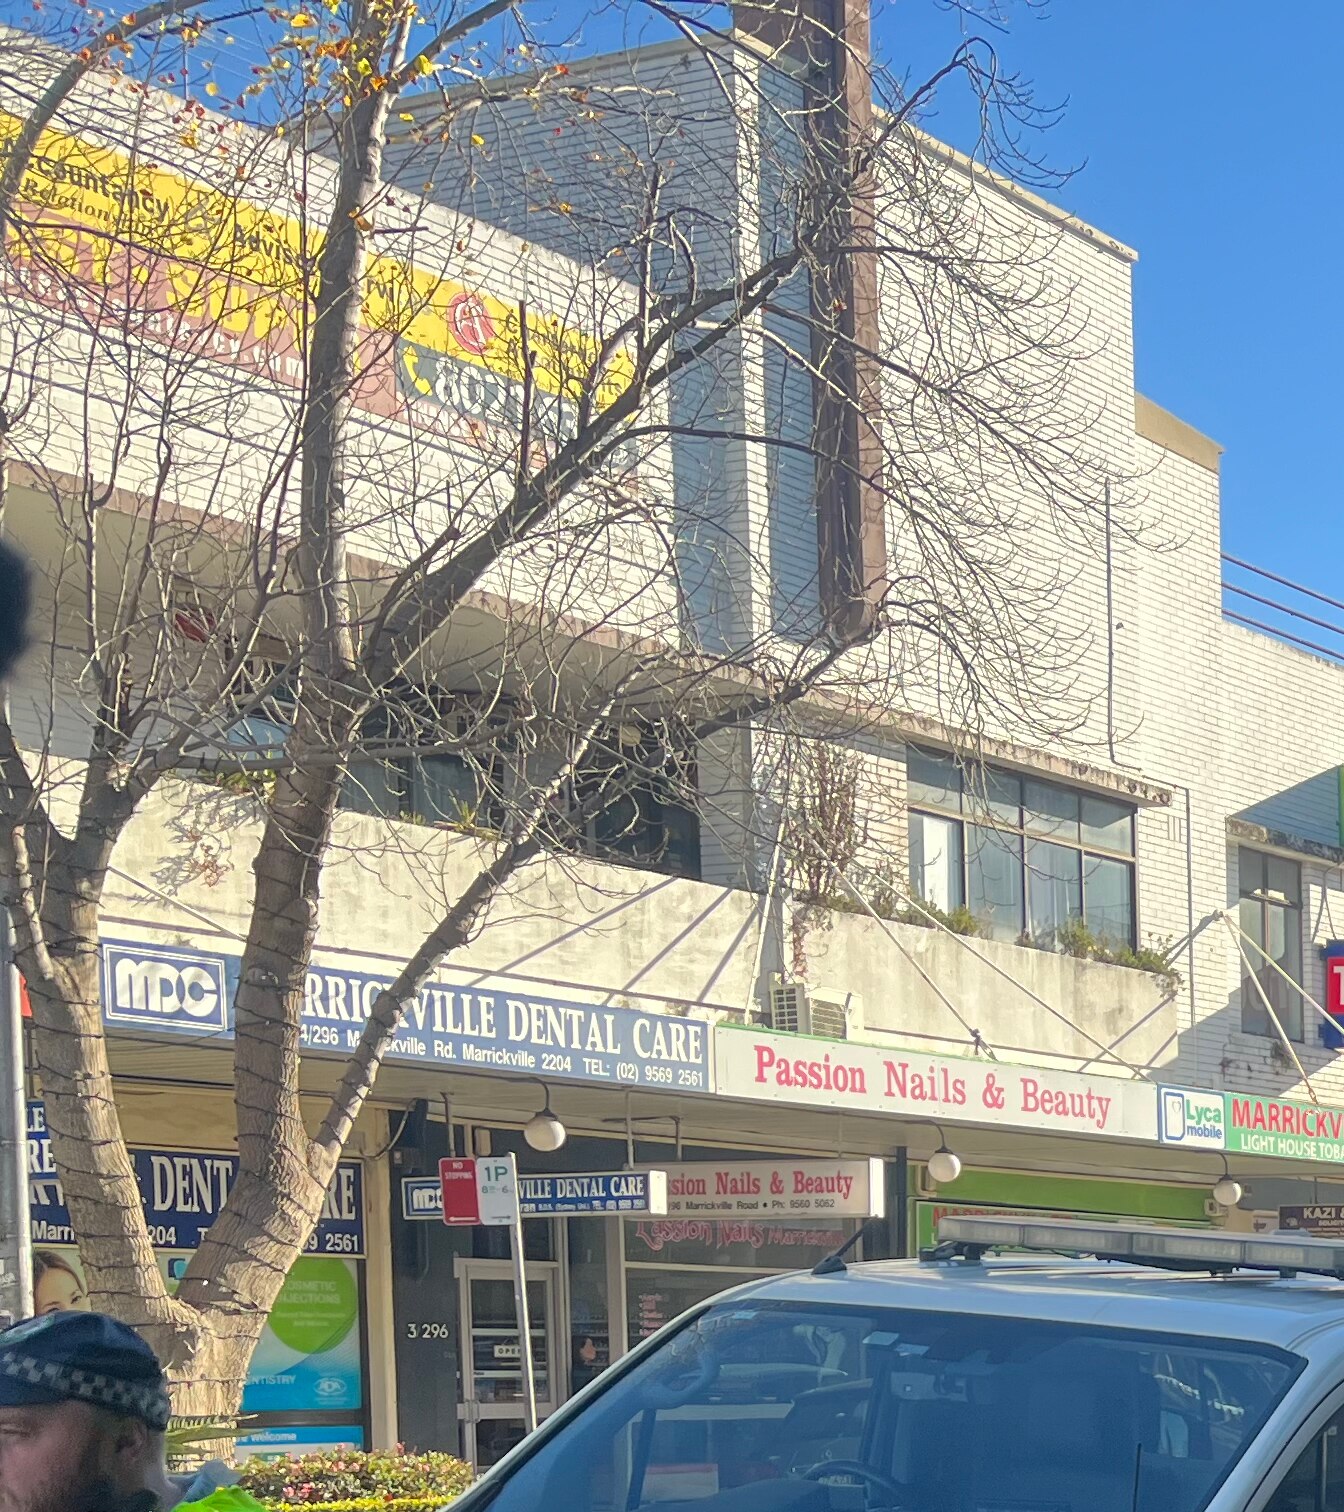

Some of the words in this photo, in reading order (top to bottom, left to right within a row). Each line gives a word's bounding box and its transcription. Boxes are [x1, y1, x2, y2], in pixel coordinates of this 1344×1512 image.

[115, 956, 218, 1018] MDC
[300, 972, 497, 1039] RRICVILLE
[506, 998, 621, 1056] DENTAL
[632, 1017, 703, 1064] CARE
[433, 1039, 457, 1060] Rd.
[462, 1042, 535, 1069] Marrickville
[541, 1052, 572, 1073] 2204
[582, 1056, 611, 1077] TEL:
[616, 1062, 640, 1082] (02)
[645, 1065, 673, 1084] 9569
[678, 1069, 704, 1088] 2561
[753, 1044, 867, 1095] Passion
[884, 1060, 967, 1105] Nails
[981, 1072, 1005, 1110] &
[1020, 1077, 1112, 1129] Beauty
[1185, 1098, 1222, 1125] Lyca
[1186, 1124, 1223, 1140] mobile
[1241, 1133, 1275, 1153] LIGHT
[1277, 1138, 1317, 1159] HOUSE
[153, 1157, 233, 1214] DENT
[484, 1166, 508, 1181] 1P
[667, 1173, 707, 1197] sion
[715, 1172, 761, 1196] Nails
[770, 1172, 785, 1195] &
[793, 1170, 854, 1200] Beauty
[556, 1178, 606, 1198] DENTAL
[610, 1176, 645, 1196] CARE
[686, 1201, 733, 1211] Marrickville
[737, 1200, 759, 1210] Road
[1303, 1207, 1336, 1219] KAZI
[325, 1235, 359, 1253] 2561
[250, 1374, 297, 1386] NTISTRY
